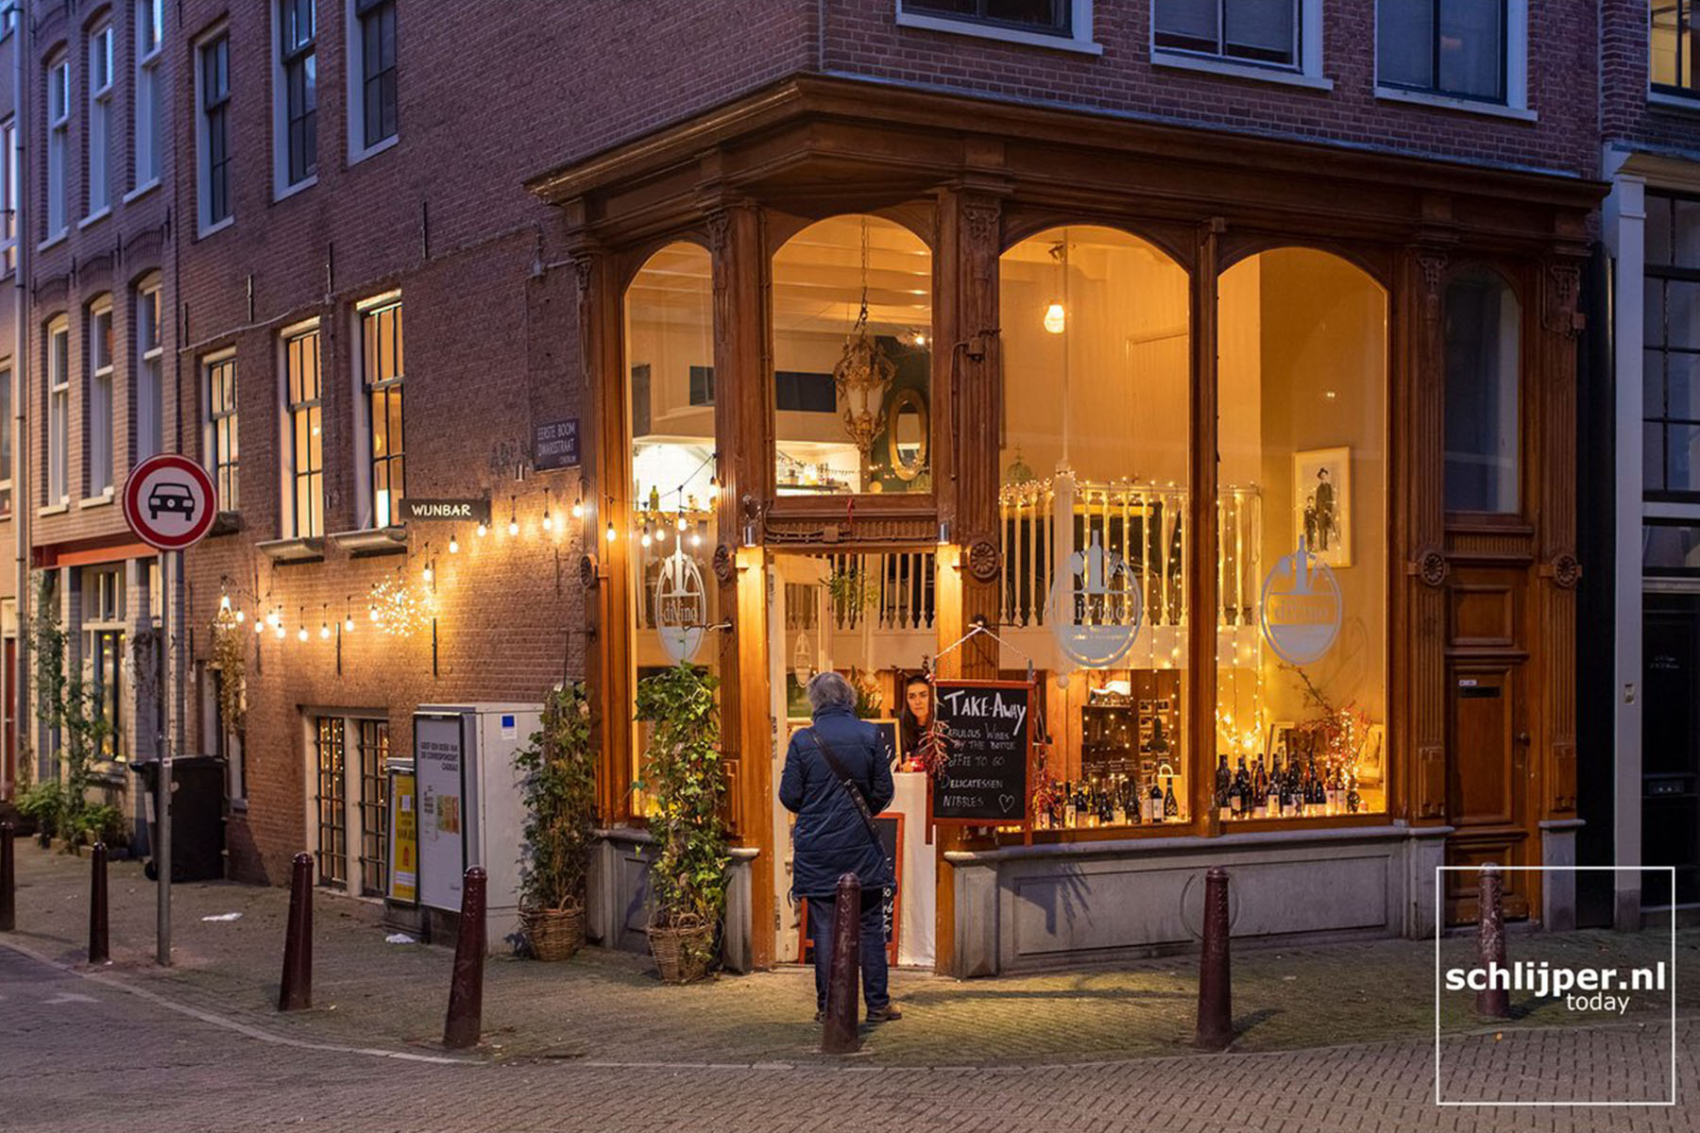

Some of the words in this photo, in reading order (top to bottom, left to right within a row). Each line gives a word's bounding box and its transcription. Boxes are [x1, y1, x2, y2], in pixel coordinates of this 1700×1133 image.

[537, 424, 556, 441] EERSTE
[557, 421, 576, 438] BOOM
[537, 438, 575, 458] DWARSSTRAAT
[411, 504, 471, 517] WIJNBAR
[945, 727, 981, 739] ABULOUS
[954, 740, 966, 751] BY
[969, 740, 985, 751] THE
[989, 740, 1018, 751] BOTTLE
[947, 753, 971, 767] OFFEE
[975, 755, 989, 767] TO
[992, 755, 1006, 767] GO
[941, 774, 1004, 790] DELICATESSEN
[942, 795, 985, 808] NIBBLES
